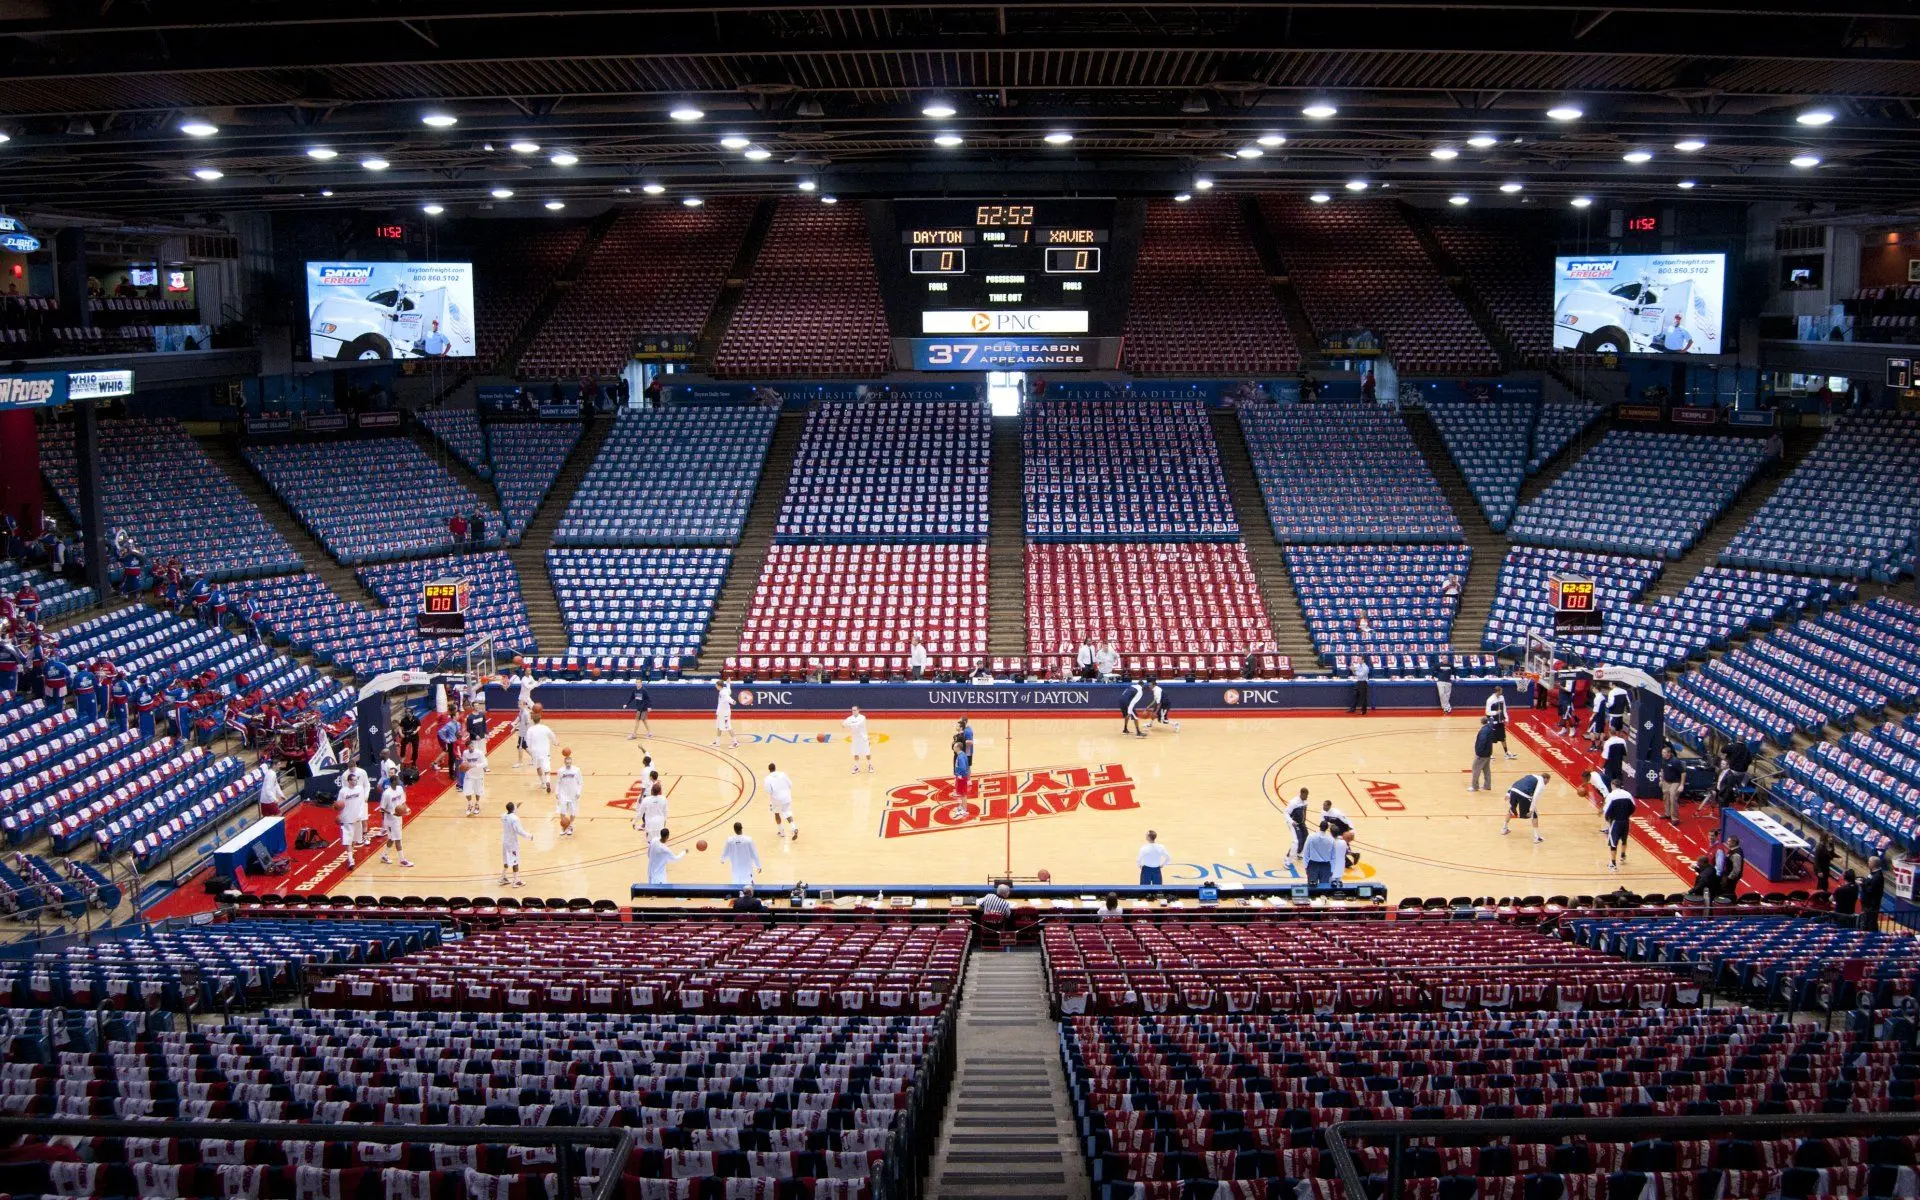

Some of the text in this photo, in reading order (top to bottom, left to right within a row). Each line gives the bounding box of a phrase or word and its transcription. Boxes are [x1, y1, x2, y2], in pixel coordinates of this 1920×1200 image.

[977, 206, 1033, 225] 62:52
[1629, 219, 1656, 230] 11:52
[376, 227, 401, 238] 11:52
[913, 231, 962, 243] DAYTON
[983, 232, 1005, 241] PERIOD
[1050, 230, 1093, 243] XAVIER
[941, 252, 953, 270] 0
[1075, 251, 1088, 269] 0
[1571, 261, 1616, 271] DAYTON
[1653, 259, 1715, 267] daytonfreight.com
[325, 267, 371, 278] DAYTON
[1570, 270, 1611, 278] FREIGHT
[323, 276, 367, 285] FREIGHT
[986, 275, 1025, 283] POSSESSION
[929, 282, 948, 291] FOULS
[1063, 281, 1082, 290] FOULS
[989, 294, 1023, 302] TIME OUT
[997, 314, 1041, 330] PNC
[929, 344, 978, 364] 37
[11, 378, 54, 402] FLYERS
[99, 381, 123, 393] WHIO
[784, 391, 858, 400] UNIVERSITY
[888, 391, 944, 399] DAYTON
[1067, 390, 1208, 399] FLYER TRADITION
[427, 586, 455, 596] 62:52
[1562, 583, 1592, 593] 62:52
[432, 598, 451, 611] 00
[1567, 595, 1587, 608] 00
[756, 691, 792, 705] PNC
[928, 691, 1089, 704] UNIVERSITY of DAYTON
[1242, 690, 1279, 704] PNC
[891, 764, 1133, 808] FLYERS
[1358, 779, 1405, 811] A10
[884, 784, 1141, 839] DAYTON
[1629, 816, 1683, 854] University
[1172, 862, 1307, 880] PNC
